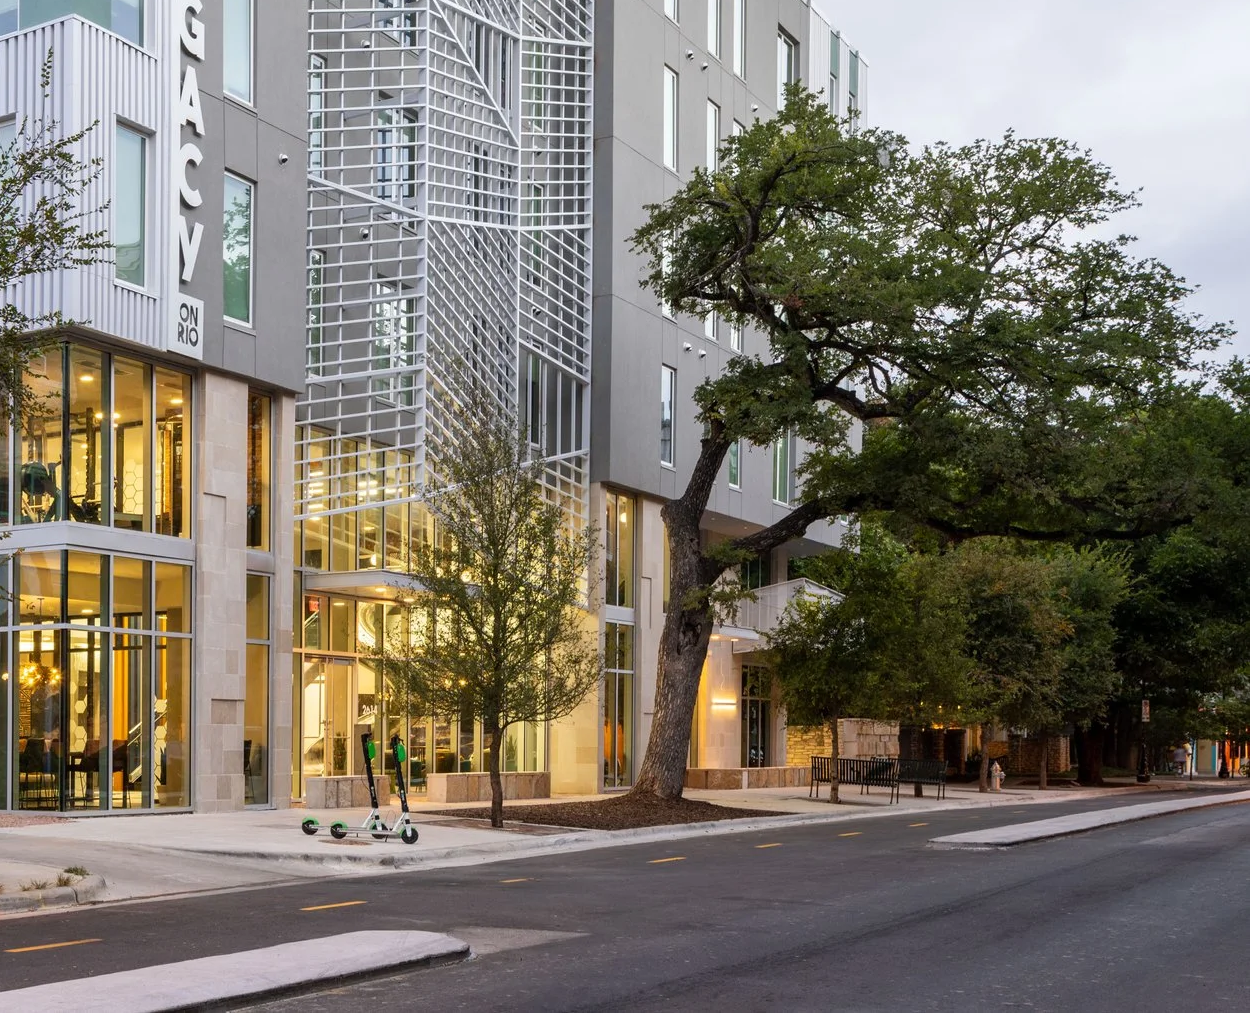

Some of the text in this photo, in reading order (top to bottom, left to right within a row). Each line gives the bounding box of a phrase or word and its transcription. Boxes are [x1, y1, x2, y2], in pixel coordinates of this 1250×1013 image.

[179, 302, 199, 327] ON
[177, 321, 199, 347] RIO
[362, 704, 378, 715] 2614
